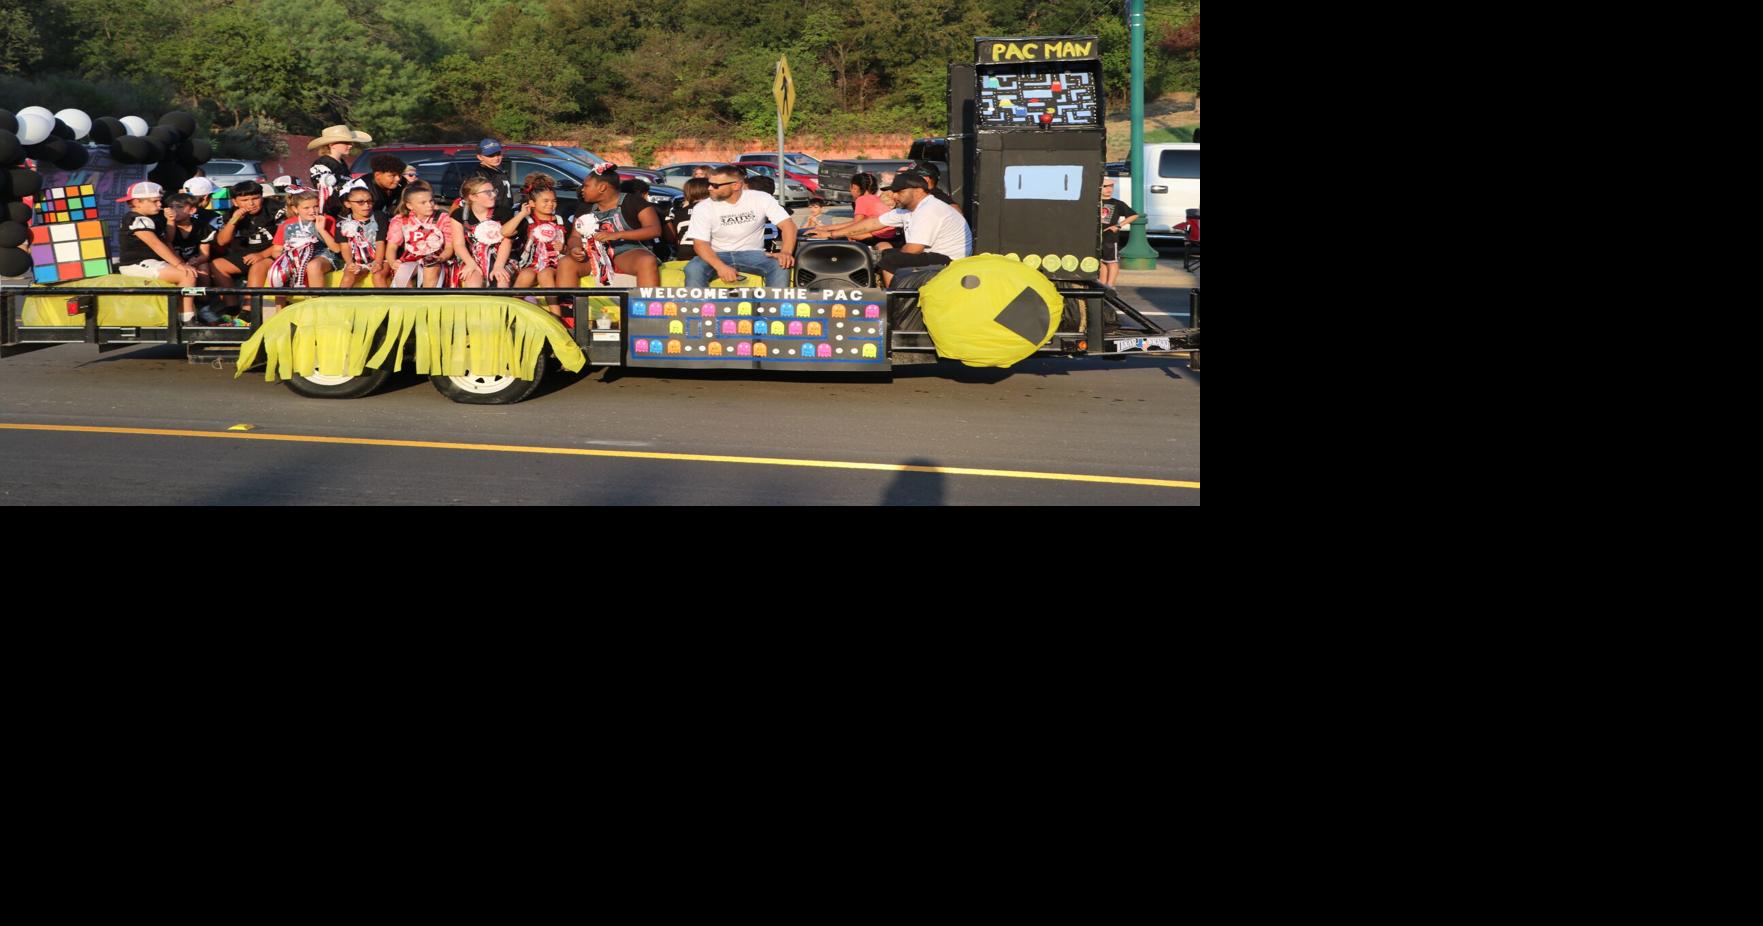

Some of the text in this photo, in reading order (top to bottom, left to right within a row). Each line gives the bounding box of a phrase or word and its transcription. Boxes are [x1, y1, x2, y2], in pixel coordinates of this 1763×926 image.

[992, 41, 1092, 61] PAC MAN
[640, 287, 863, 301] WELCOME TO THE PAC
